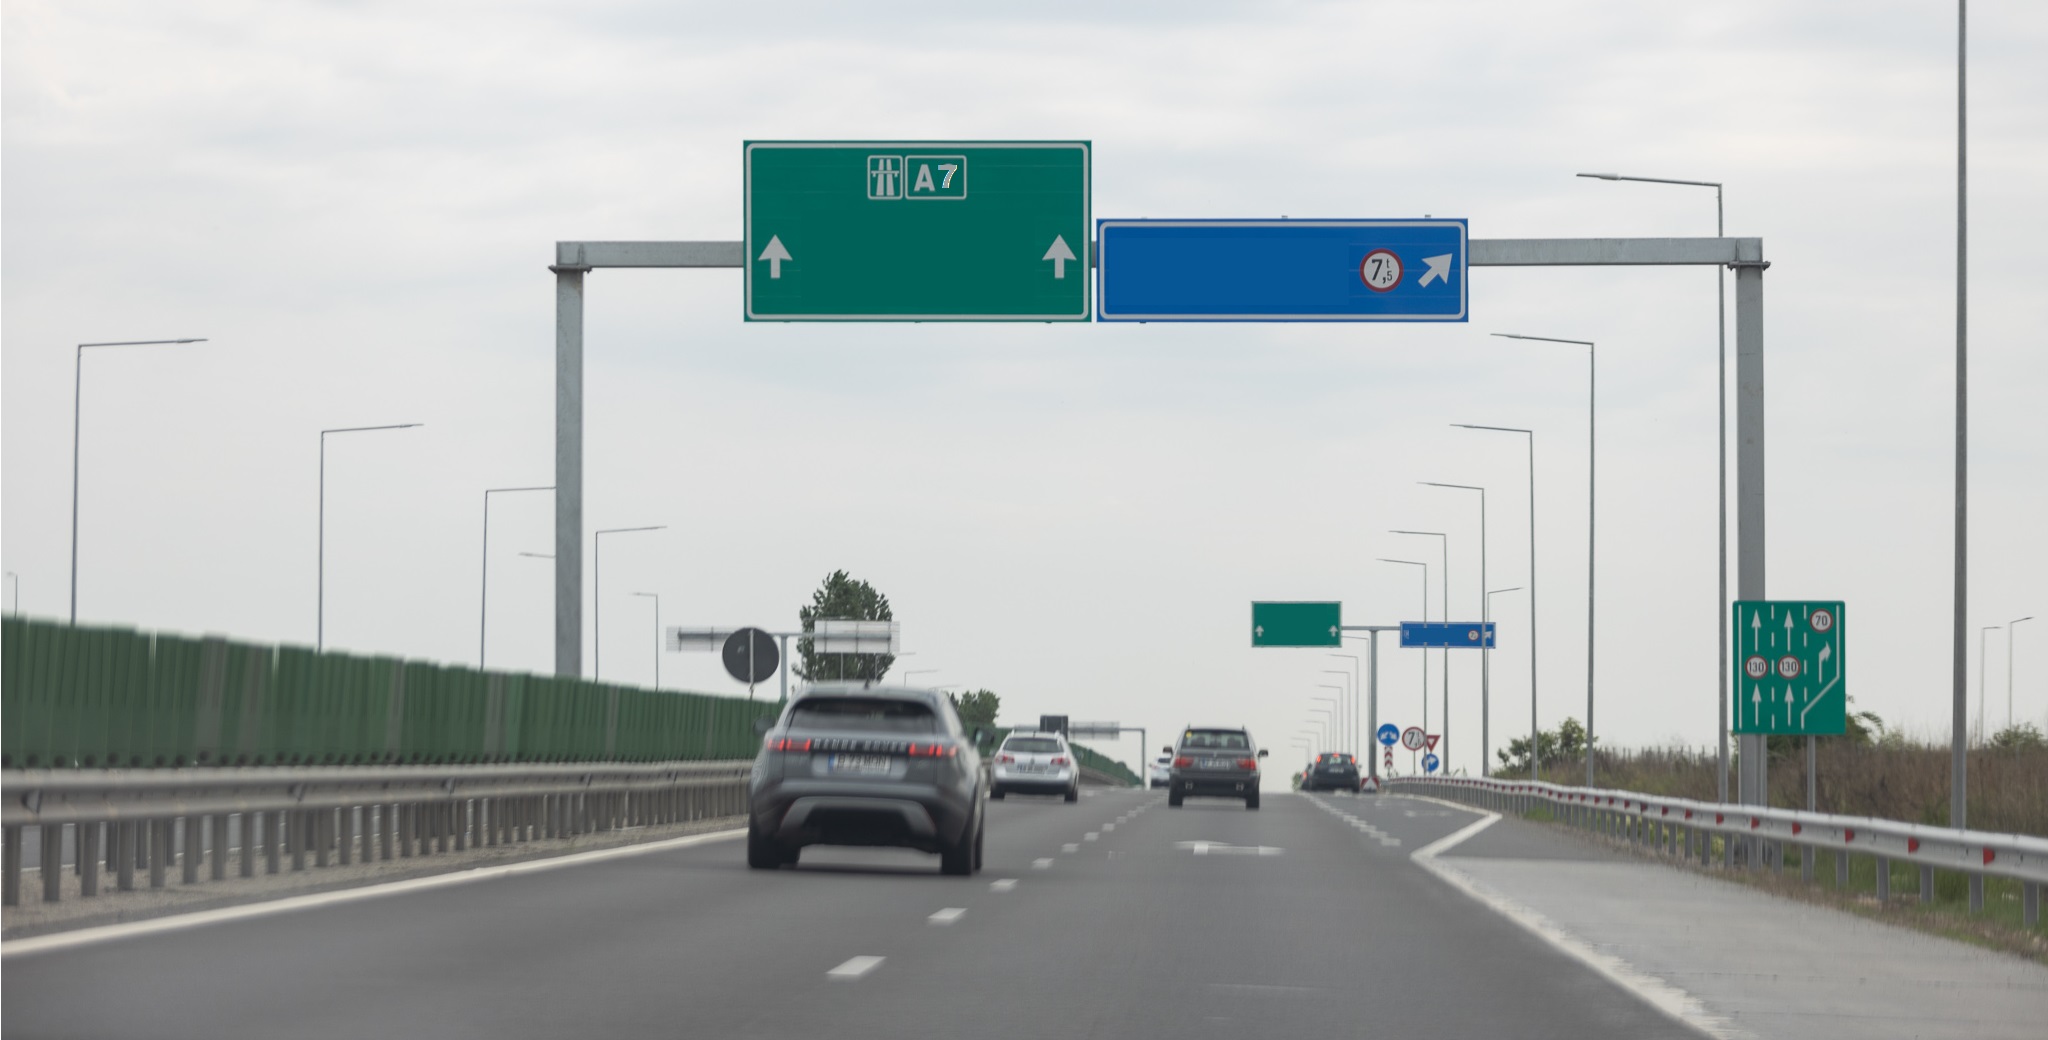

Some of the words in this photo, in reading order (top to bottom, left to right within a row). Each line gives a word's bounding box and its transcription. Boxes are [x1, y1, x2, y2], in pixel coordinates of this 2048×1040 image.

[1815, 615, 1828, 626] 70
[1748, 661, 1765, 673] 130
[1781, 661, 1798, 673] 130
